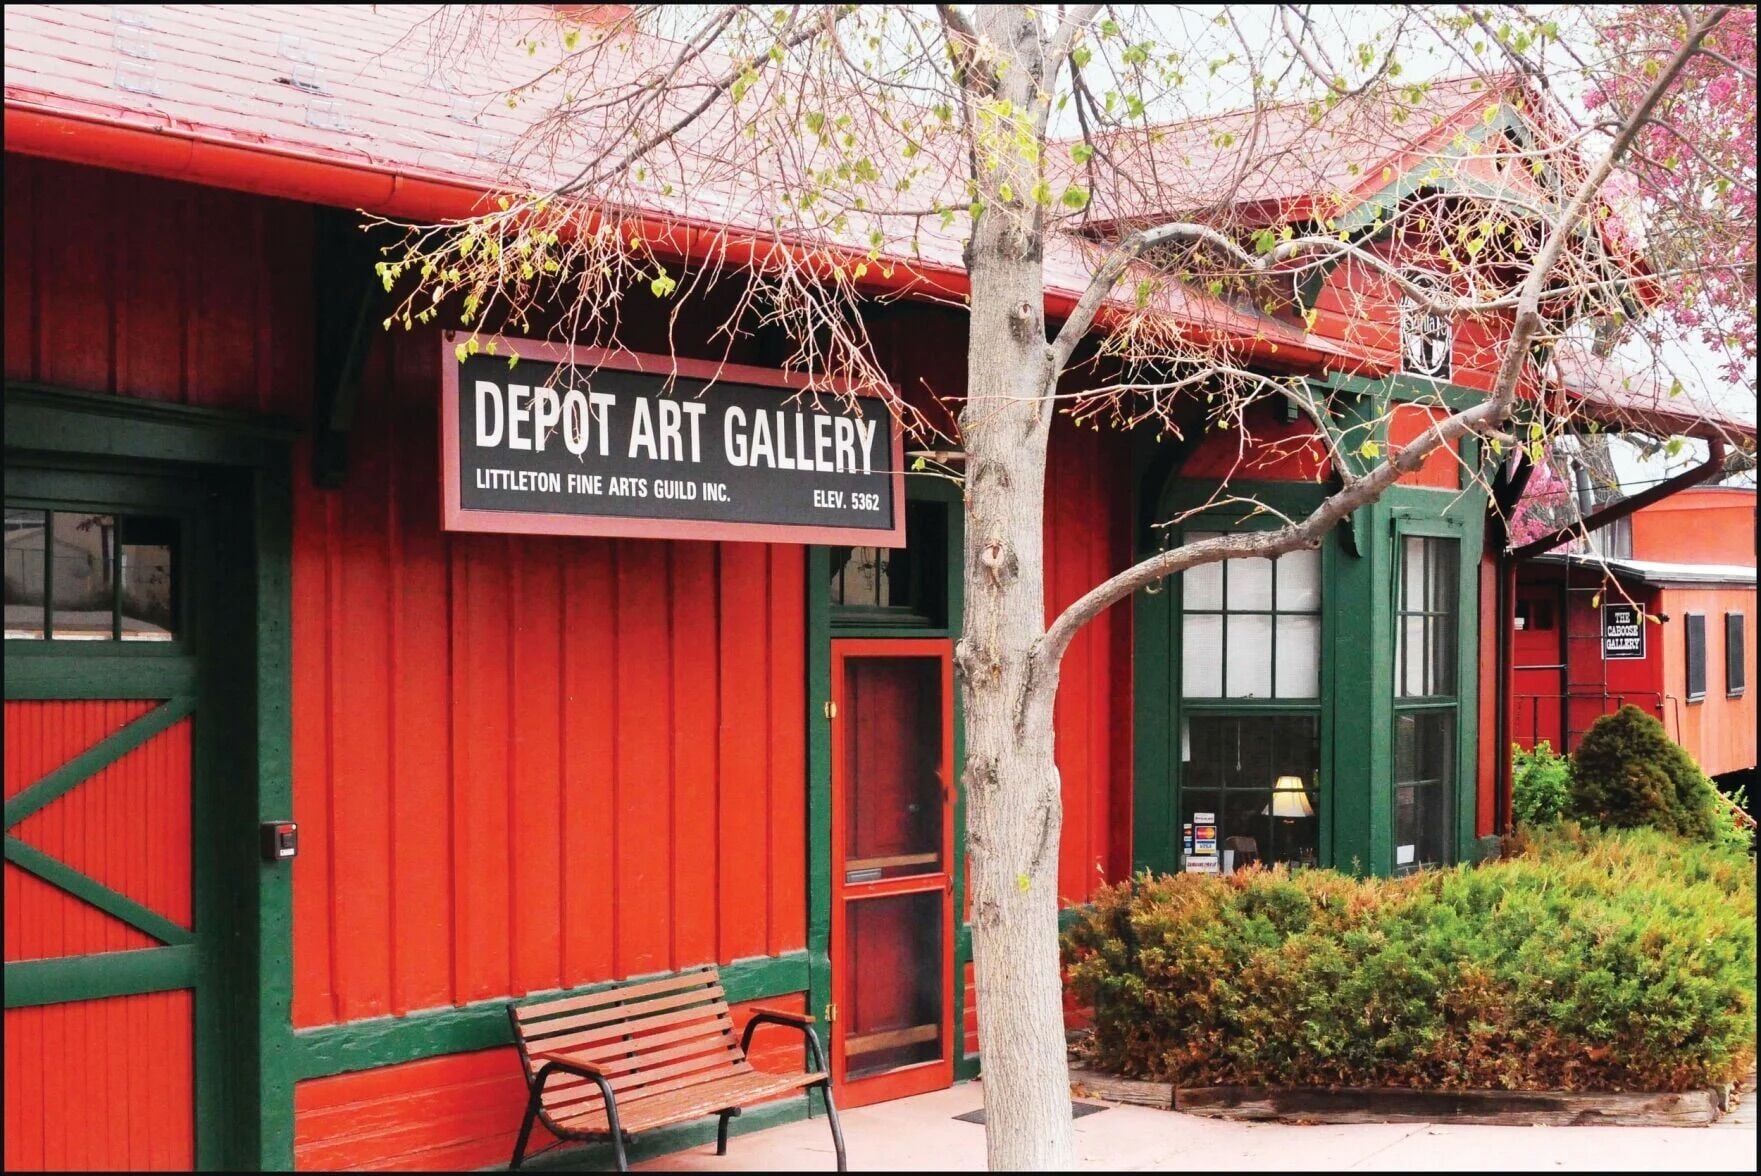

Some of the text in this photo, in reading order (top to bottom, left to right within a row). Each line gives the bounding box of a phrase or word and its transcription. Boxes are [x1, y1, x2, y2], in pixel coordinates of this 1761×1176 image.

[475, 380, 877, 475] DEPOT ART GALLERY
[476, 468, 732, 503] LITTLETON FINE ARTS GUILD INC.
[813, 490, 880, 512] ELEV. 5362
[1615, 612, 1630, 624] THE
[1607, 625, 1638, 637] CABOOSE
[1606, 638, 1640, 650] GALLERY
